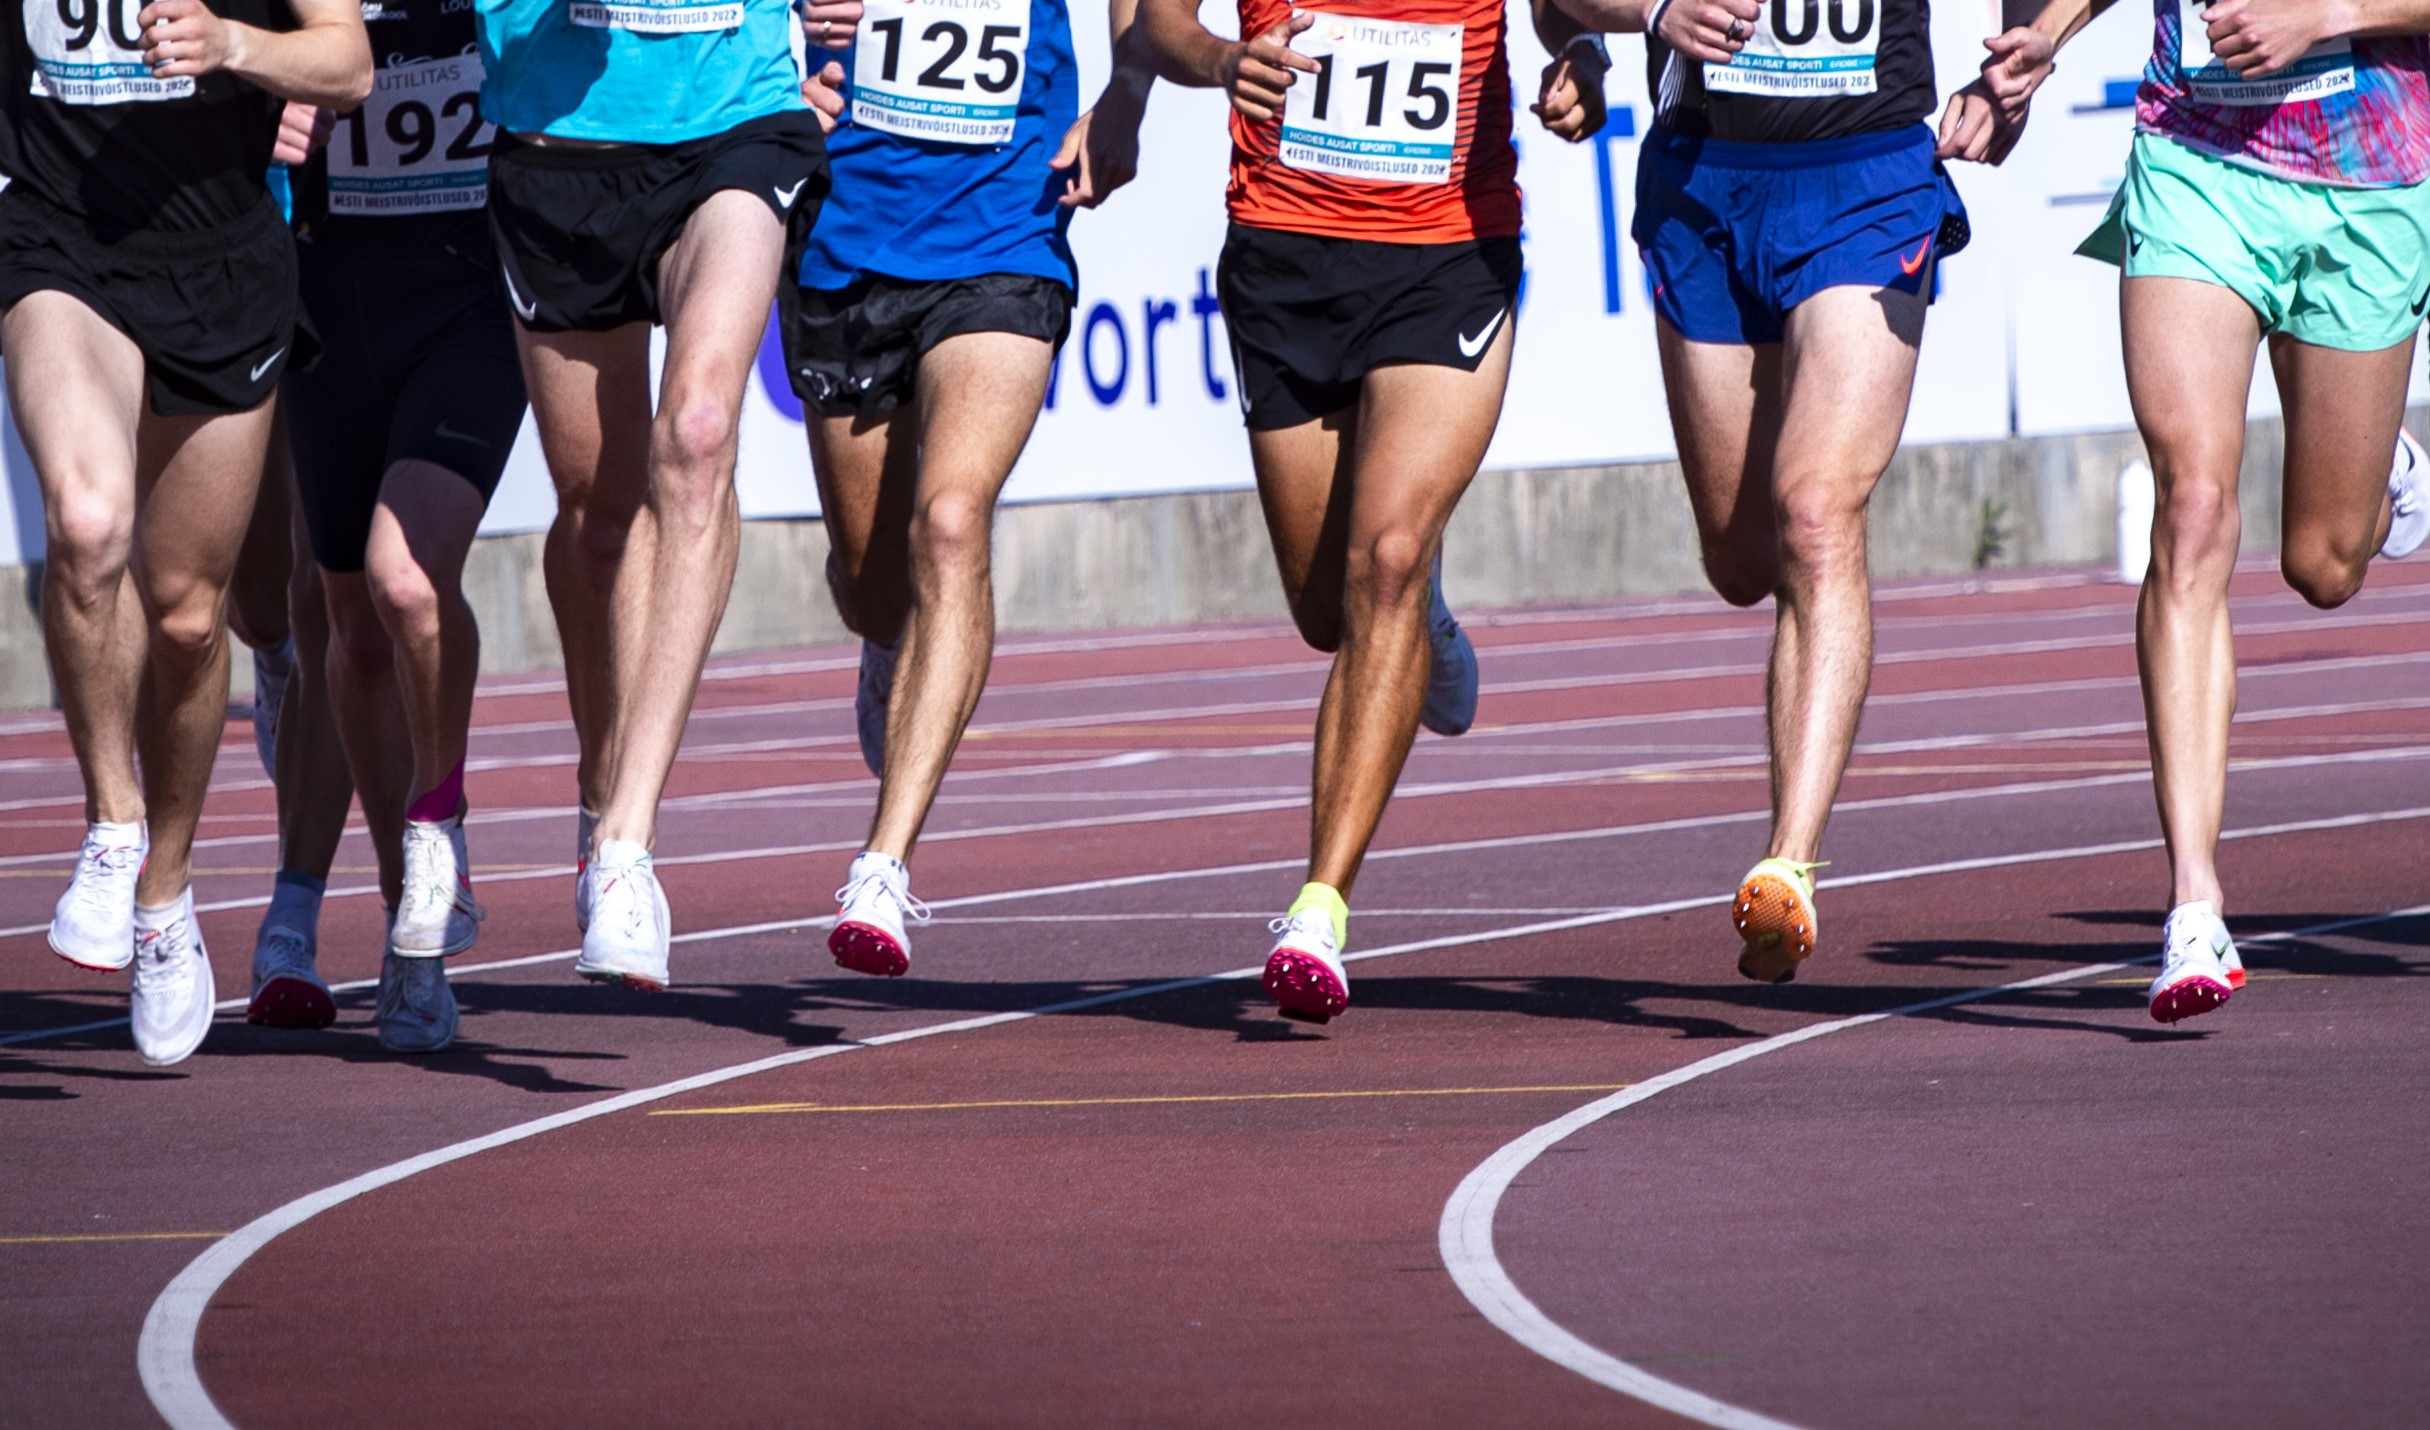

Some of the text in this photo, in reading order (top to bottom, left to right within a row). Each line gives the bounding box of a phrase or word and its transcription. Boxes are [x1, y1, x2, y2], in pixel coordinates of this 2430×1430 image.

[1771, 0, 1875, 45] 00
[1353, 27, 1431, 47] UTILITAS
[871, 17, 1021, 93] 125
[1752, 57, 1784, 68] AUSAT
[1787, 58, 1822, 69] SPORTI
[98, 65, 136, 77] SPORTI
[378, 65, 460, 91] UTILITAS
[861, 90, 894, 103] HOIDES
[896, 98, 928, 111] AUSAT
[930, 103, 966, 115] SPORTI
[1311, 53, 1452, 130] 115
[336, 91, 492, 167] 192
[1289, 131, 1324, 145] HOIDES
[1327, 139, 1357, 151] AUSAT
[1359, 142, 1396, 154] SPORTI
[1046, 266, 1226, 410] ort
